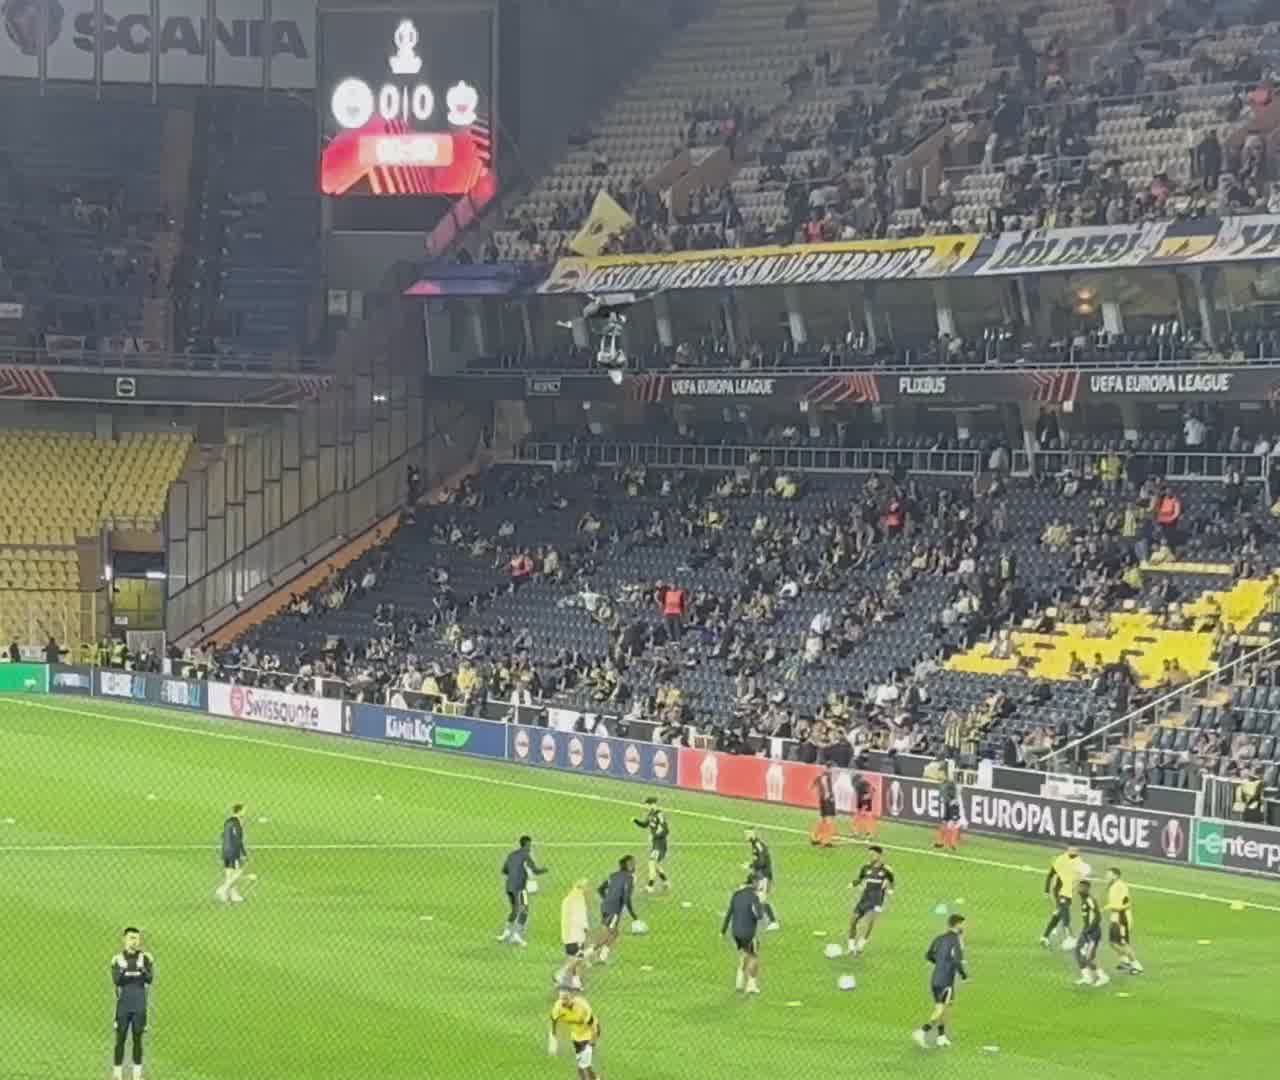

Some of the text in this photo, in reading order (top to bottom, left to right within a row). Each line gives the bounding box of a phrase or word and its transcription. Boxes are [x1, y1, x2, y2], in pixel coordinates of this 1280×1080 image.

[73, 12, 308, 60] SCANIA
[672, 378, 773, 395] UEFA EUROPA LEAGUE
[1090, 373, 1230, 392] UEFA EUROPA LEAGUE
[971, 795, 1055, 838] EUROPA
[1061, 807, 1151, 850] LEAGUE
